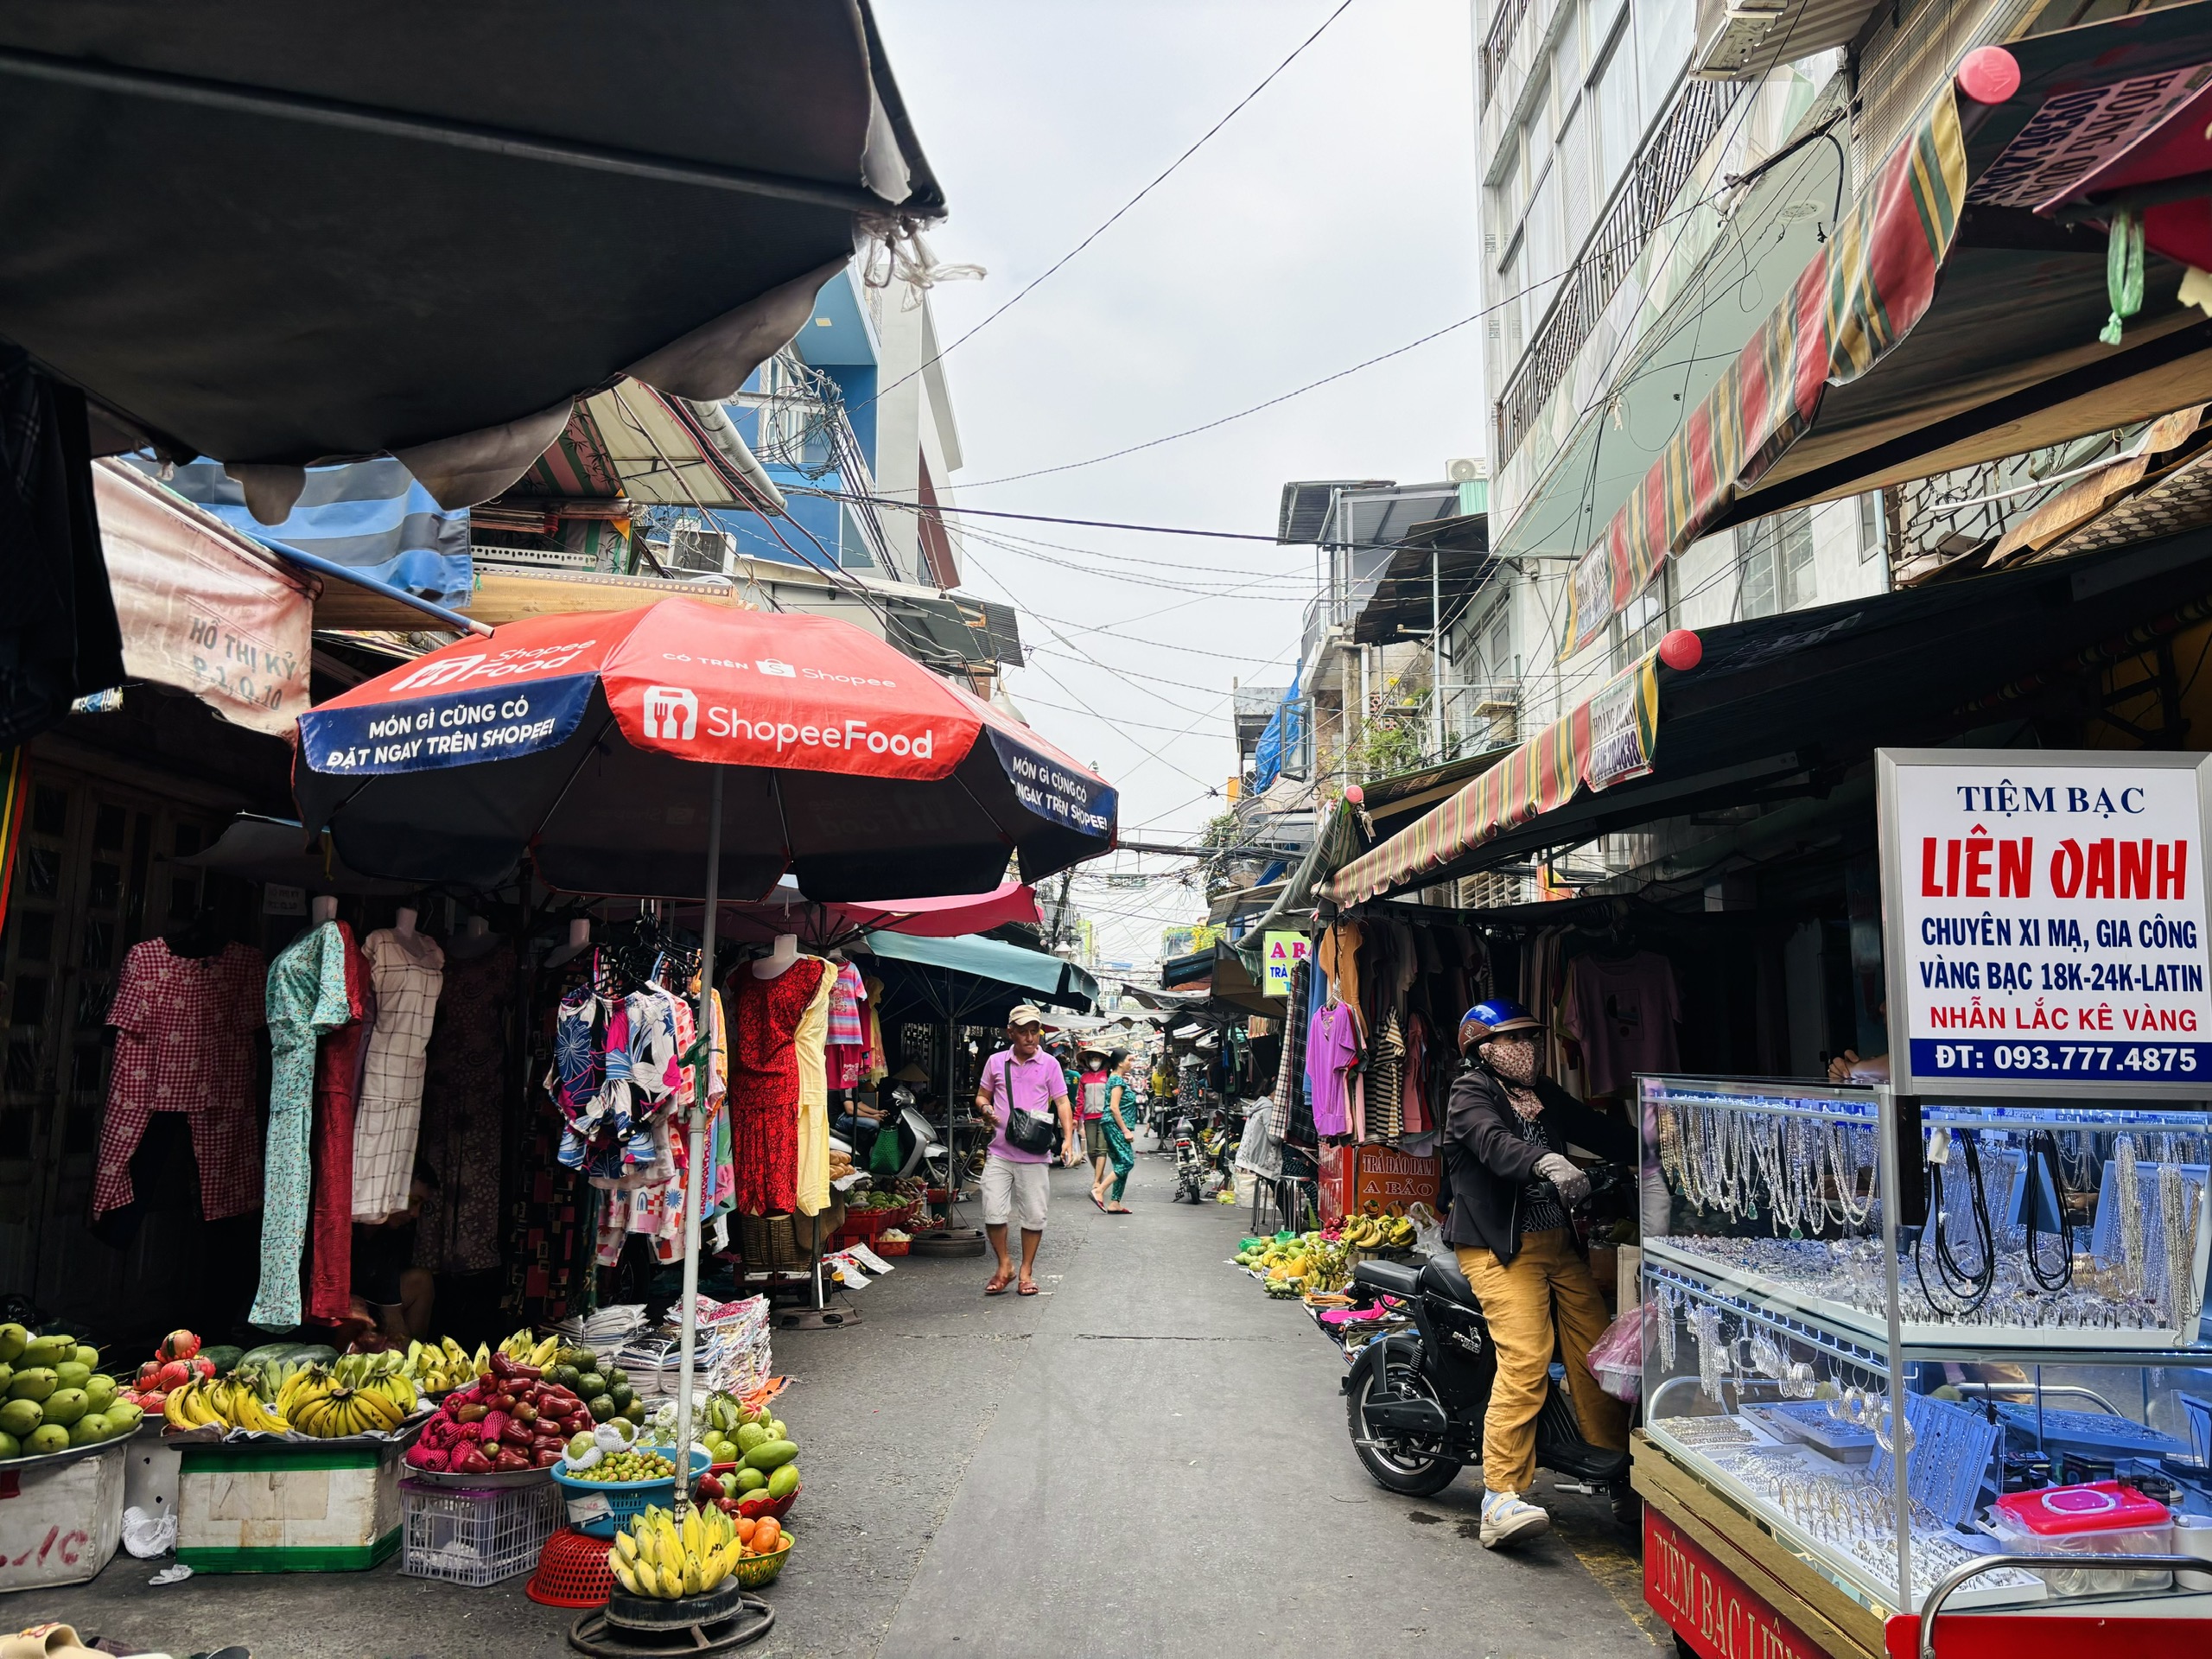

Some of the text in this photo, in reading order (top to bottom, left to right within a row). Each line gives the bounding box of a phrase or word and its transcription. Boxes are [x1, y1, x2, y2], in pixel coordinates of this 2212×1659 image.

[189, 617, 296, 680] HỒ THỊ KỶ
[462, 650, 584, 681] Food
[490, 639, 596, 663] Shopee
[662, 653, 691, 662] CÓ
[696, 657, 749, 670] TRÊN
[801, 668, 897, 688] Shopee
[369, 695, 529, 740] MÓN GÌ CŨNG CÓ
[707, 706, 933, 759] ShopeeFood
[326, 717, 556, 770] ĐẶT NGAY TRÊN SHOPEE!
[1013, 756, 1037, 779] MÓN
[1076, 785, 1087, 804] CÓ
[1956, 779, 2145, 819] TIỆM BẠC
[1016, 782, 1043, 805] NGAY
[1071, 804, 1107, 830] SHOPEE!
[1921, 823, 2188, 899] LIÊN OANH
[1270, 942, 1287, 958] A
[1922, 911, 2196, 952] CHUYÊN XI MẠ, GIA CÔNG
[1269, 963, 1288, 977] TRÀ
[1920, 954, 2202, 995] VÀNG BẠC 18K-24K-LATIN
[1930, 996, 2196, 1032] NHẪN LẮC KÊ VÀNG
[1936, 1045, 2196, 1071] ĐT: 093.777.4875
[1363, 1179, 1433, 1196] A BẢO
[1653, 1529, 1695, 1625] TIỆM
